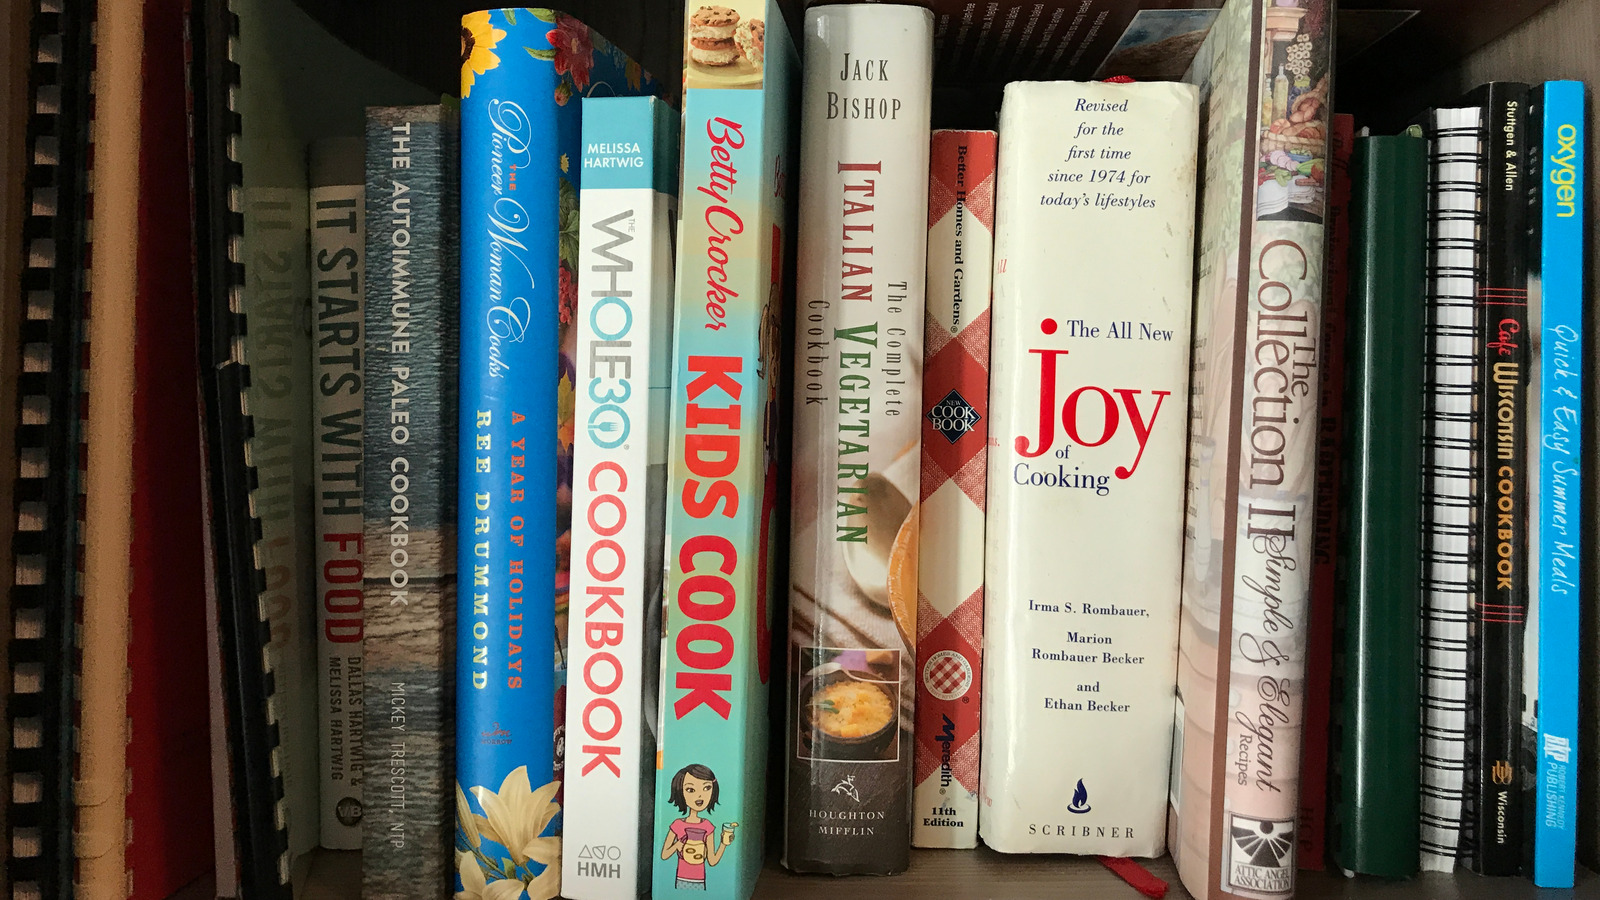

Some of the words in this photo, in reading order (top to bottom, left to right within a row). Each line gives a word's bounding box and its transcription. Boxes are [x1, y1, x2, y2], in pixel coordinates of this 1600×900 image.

[840, 53, 889, 81] JACK
[826, 91, 901, 120] BISHOP
[1074, 98, 1129, 112] Revised
[1503, 100, 1518, 146] Stuttgen
[392, 122, 411, 168] THE
[488, 98, 532, 195] Pioneer
[588, 143, 641, 154] MELISSA
[1073, 122, 1097, 138] for
[1102, 122, 1124, 136] the
[584, 157, 644, 168] HARTWIG
[697, 116, 745, 204] Betty
[957, 145, 968, 187] Better
[1064, 145, 1095, 162] first
[1100, 146, 1132, 159] time
[1505, 162, 1518, 191] Allen
[1506, 150, 1517, 158] &
[1550, 123, 1576, 217] oxygen
[509, 164, 517, 191] THE
[1047, 169, 1083, 182] since
[1089, 169, 1126, 183] 1974
[1127, 170, 1150, 187] for
[316, 199, 357, 234] IT
[955, 190, 966, 237] Homes
[1040, 192, 1090, 209] today's
[1094, 193, 1156, 211] lifestyles
[487, 197, 535, 289] Woman
[838, 160, 882, 302] ITALIAN
[954, 239, 965, 265] and
[391, 180, 411, 353] AUTOIMMUNE
[705, 205, 744, 332] Crocker
[887, 281, 908, 314] The
[317, 248, 362, 396] STARTS
[487, 297, 531, 378] Cooks
[1067, 319, 1100, 338] The
[1106, 321, 1132, 340] All
[1139, 322, 1174, 341] New
[1486, 317, 1521, 356] Cafe
[806, 300, 830, 406] Cookbook
[882, 327, 907, 417] Complete
[1249, 239, 1308, 489] Collection
[1290, 338, 1317, 397] The
[1548, 324, 1578, 379] Quick
[391, 366, 410, 445] PALEO
[511, 411, 526, 425] A
[931, 405, 975, 419] COOK
[931, 418, 975, 432] BOOK
[475, 410, 492, 473] REE
[681, 355, 743, 519] KIDS
[834, 321, 878, 545] VEGETARIAN
[1055, 444, 1071, 459] of
[1542, 405, 1578, 455] Easy
[320, 409, 363, 515] WITH
[510, 437, 526, 504] YEAR
[1014, 462, 1110, 496] Cooking
[1551, 460, 1579, 536] Summer
[390, 457, 410, 606] COOKBOOK
[509, 516, 524, 547] OF
[1247, 503, 1296, 541] II
[1496, 465, 1514, 590] COOKBOOK
[323, 533, 364, 643] FOOD
[472, 492, 491, 690] DRUMMOND
[1242, 528, 1297, 634] Simple
[1551, 541, 1576, 595] Meals
[507, 559, 525, 690] HOLIDAYS
[581, 461, 628, 778] COOKBOOK
[673, 535, 738, 721] COOK
[1028, 600, 1060, 612] Irma
[1064, 602, 1077, 613] S.
[1082, 603, 1150, 617] Rombauer,
[1031, 648, 1098, 663] Rombauer
[1102, 653, 1145, 664] Becker
[1066, 632, 1112, 644] Marion
[1238, 632, 1290, 667] &
[329, 656, 342, 713] MELISSA
[347, 657, 362, 707] DALLAS
[1076, 681, 1100, 692] and
[391, 682, 406, 732] MICKEY
[1043, 698, 1083, 711] Ethan
[1087, 700, 1131, 713] Becker
[330, 720, 343, 780] HARTWIG
[348, 710, 364, 772] HARTWIG
[935, 713, 956, 787] Meredith
[1235, 675, 1291, 793] Elegant
[351, 777, 364, 786] &
[389, 742, 406, 813] TRESCOTT,
[1235, 734, 1252, 786] Recipes
[1556, 764, 1566, 793] ROBERT
[809, 809, 885, 820] HOUGHTON
[931, 807, 956, 816] 11th
[1497, 790, 1508, 844] Wisconsin
[1545, 762, 1557, 828] PUBLISHING
[1556, 795, 1566, 830] KENNEDY
[390, 822, 406, 849] NTP
[818, 826, 875, 836] MIFFLIN
[923, 818, 964, 828] Edition
[1028, 824, 1134, 838] SCRIBNER
[577, 862, 621, 878] HMH
[1234, 874, 1290, 890] ASSOCIATION
[1235, 864, 1263, 879] ATTIC
[1264, 868, 1289, 880] ANGEL
